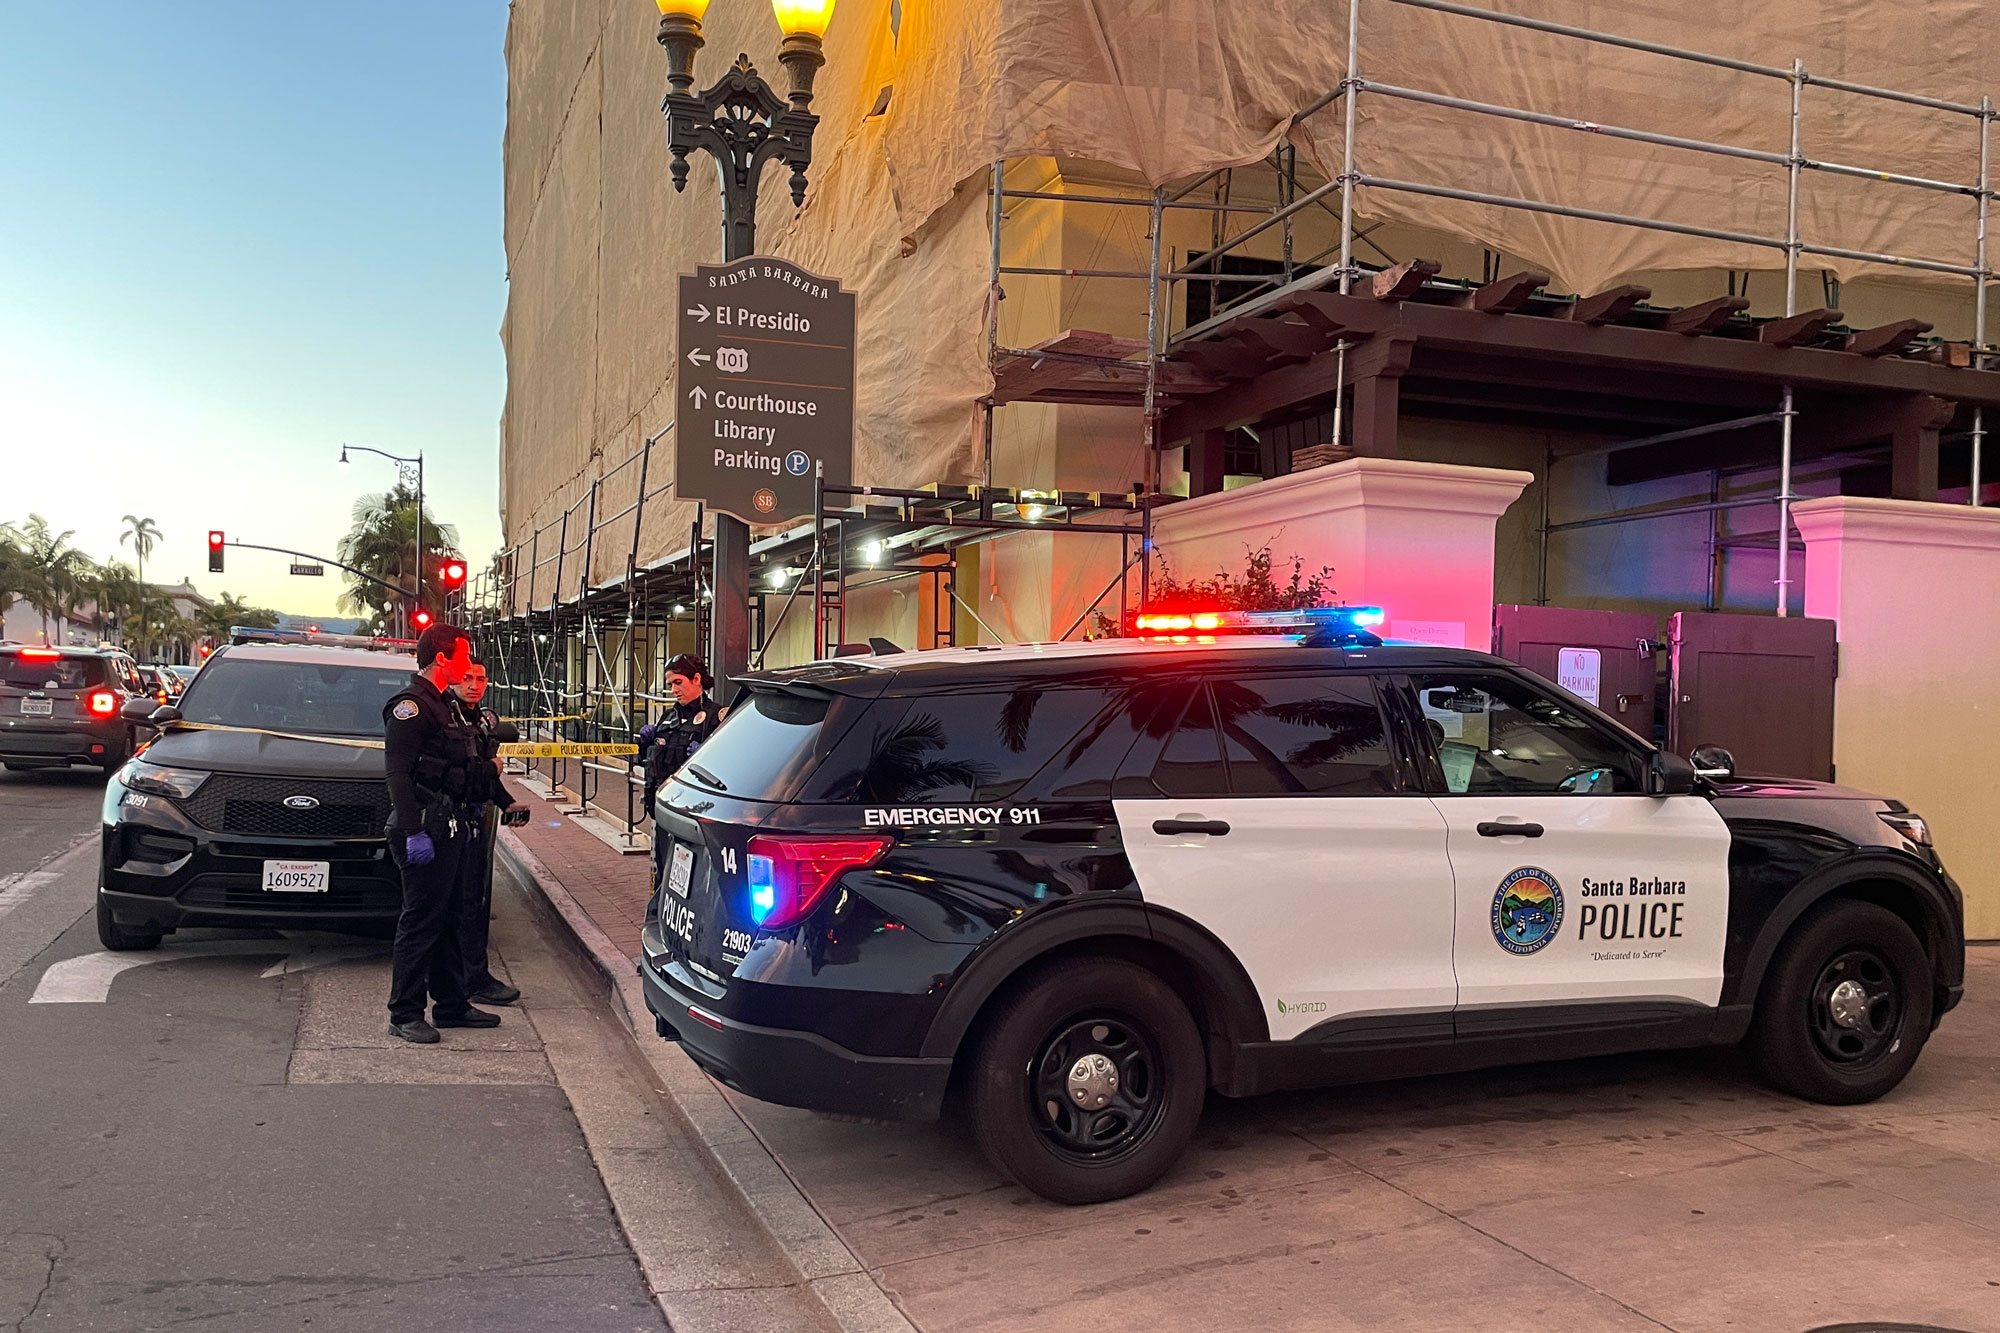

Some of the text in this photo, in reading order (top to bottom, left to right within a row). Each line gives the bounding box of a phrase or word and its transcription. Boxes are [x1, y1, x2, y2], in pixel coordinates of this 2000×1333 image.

[709, 266, 829, 299] SANTA BARBARA
[716, 306, 811, 333] El Presidio
[721, 353, 744, 368] 101
[715, 391, 817, 416] Courthouse
[714, 420, 776, 446] Library
[714, 449, 805, 475] Parking P
[758, 495, 773, 507] SB
[1574, 656, 1585, 670] NO
[1562, 676, 1596, 691] PARKING
[561, 746, 580, 755] POLICE
[581, 746, 593, 754] LINE
[594, 746, 602, 754] DO
[126, 793, 149, 808] 3091
[291, 798, 312, 807] Ford
[864, 808, 1041, 826] EMERGENCY 911
[721, 847, 737, 875] 14
[267, 872, 324, 887] 1609527
[1498, 880, 1511, 896] THE
[1510, 870, 1527, 880] CITY
[1529, 869, 1540, 877] OF
[1541, 873, 1559, 895] SANTA
[1581, 876, 1686, 897] Santa Barbara
[662, 893, 695, 942] POLICE
[1578, 902, 1684, 940] POLICE
[722, 928, 752, 953] 21903
[1502, 939, 1547, 953] CALIFORNIA
[1633, 951, 1640, 959] to
[1288, 1002, 1327, 1013] HYBRID
